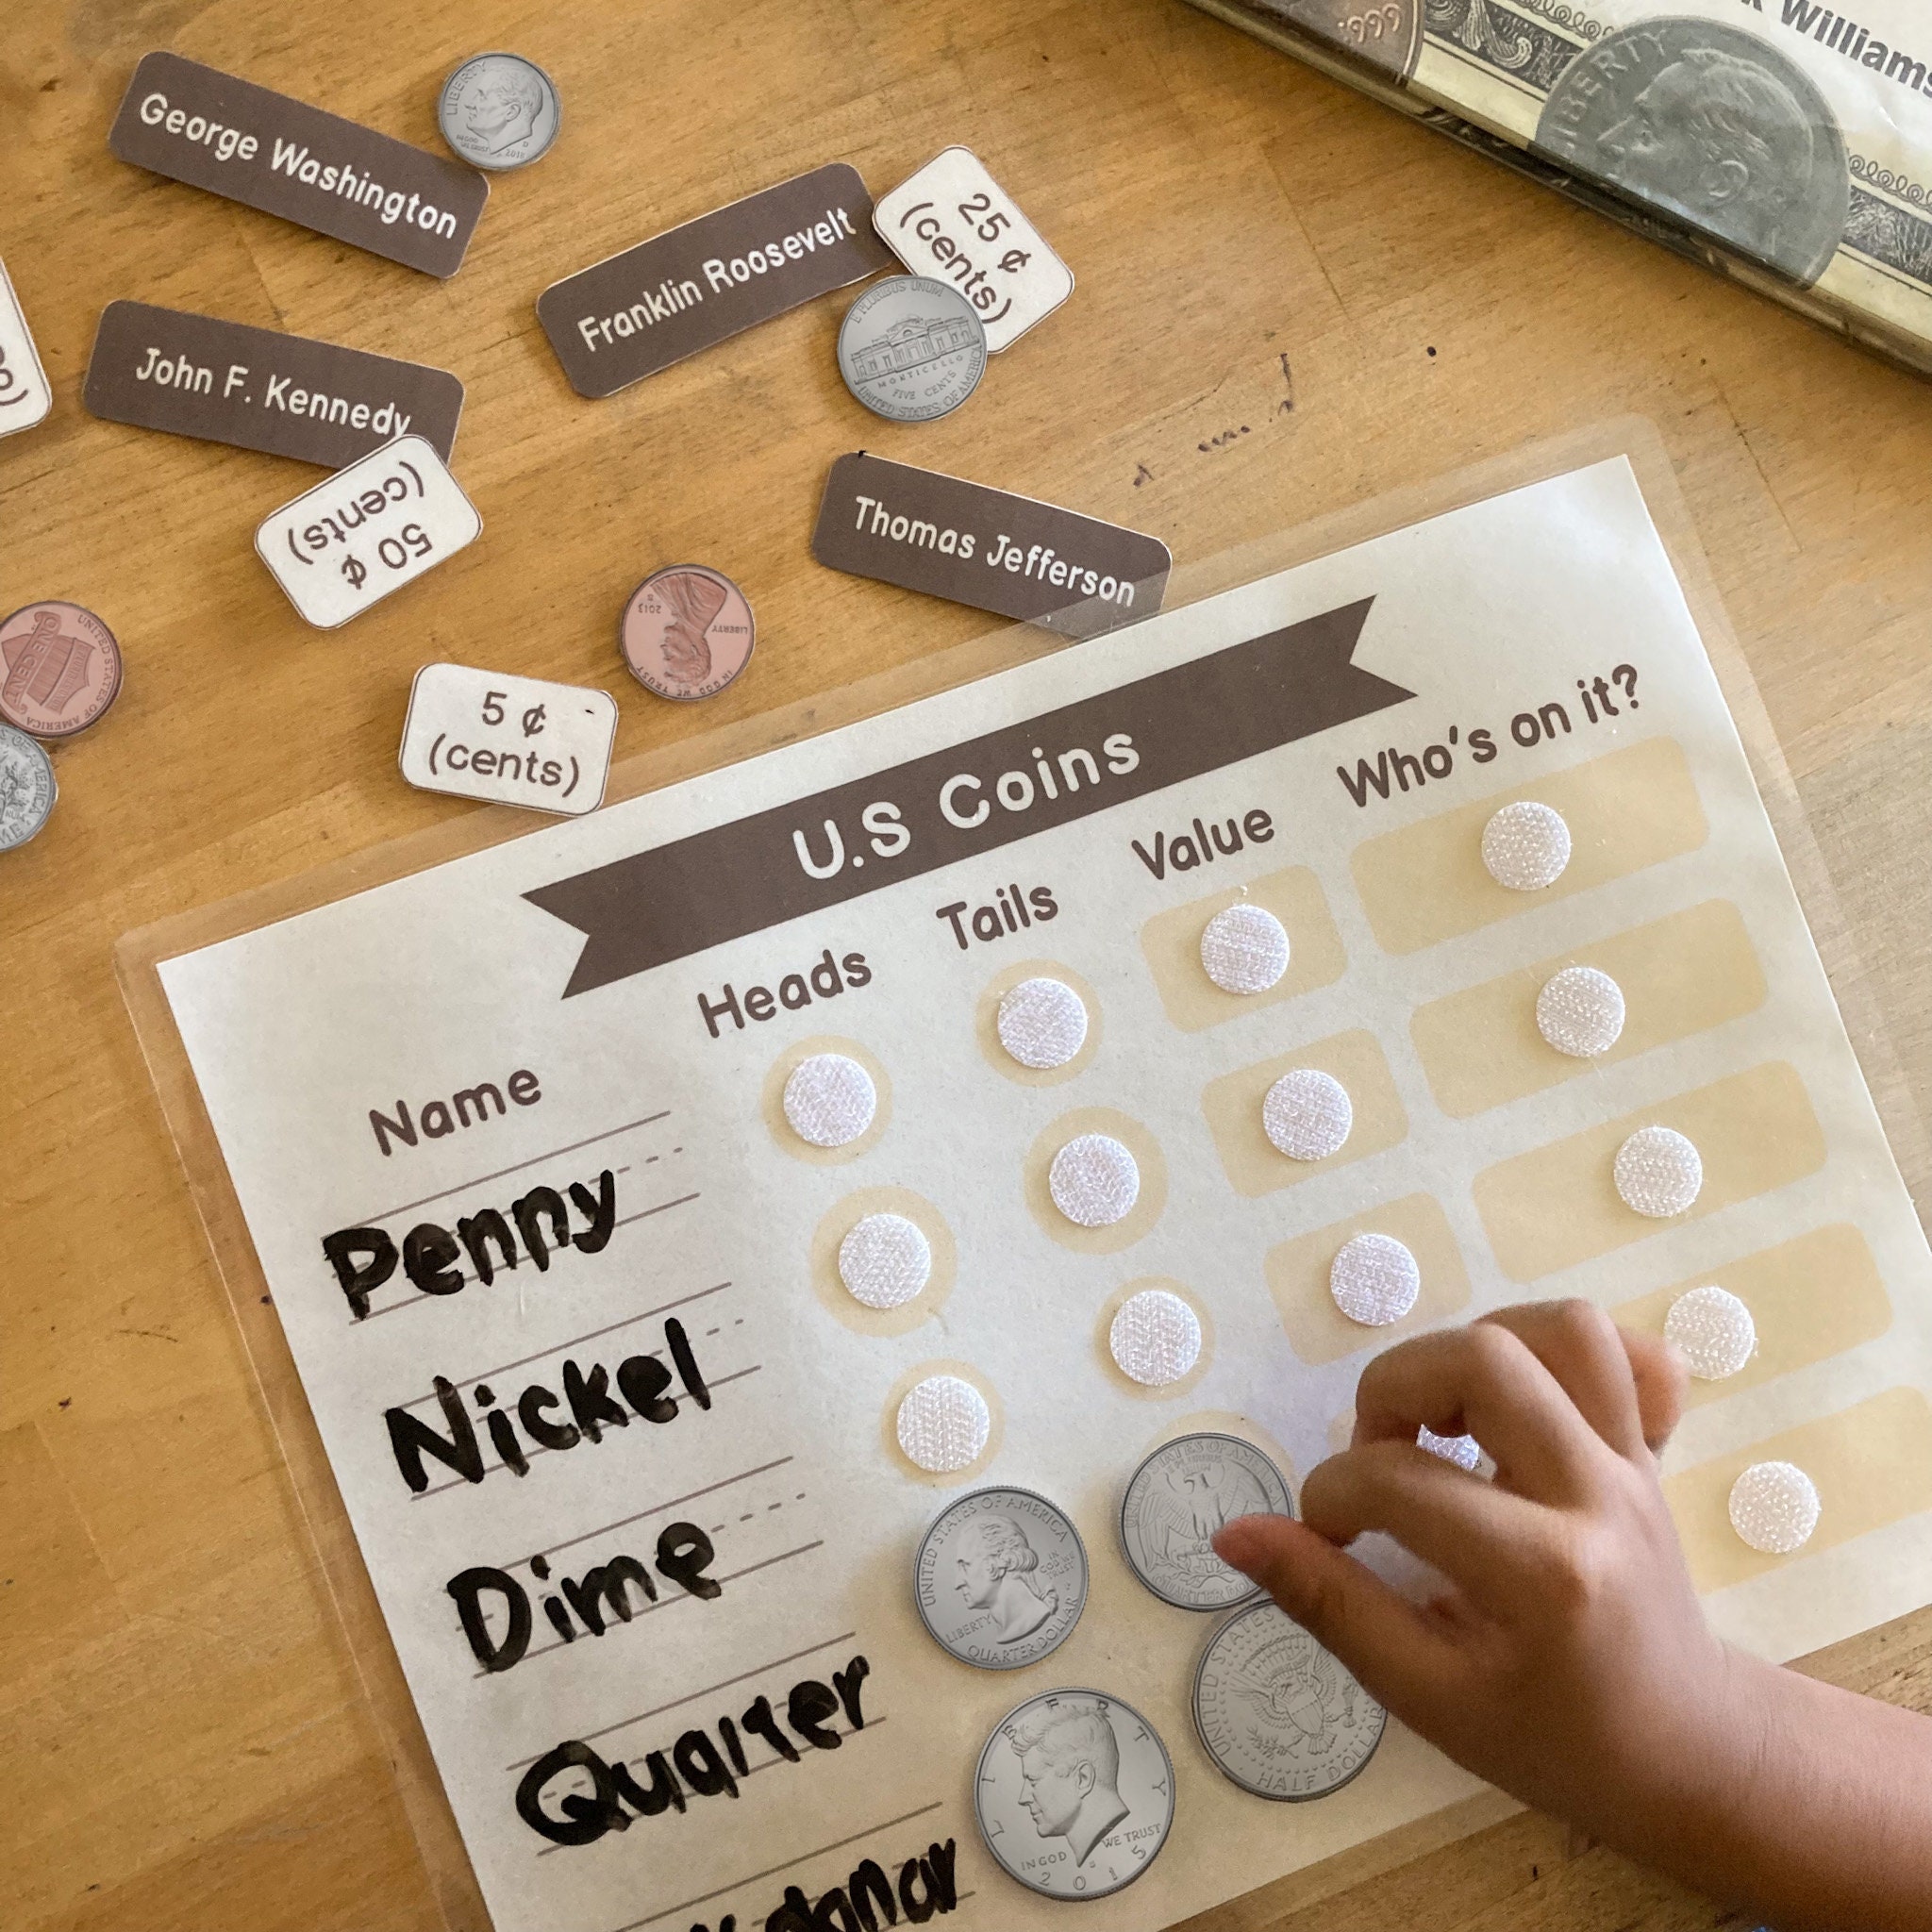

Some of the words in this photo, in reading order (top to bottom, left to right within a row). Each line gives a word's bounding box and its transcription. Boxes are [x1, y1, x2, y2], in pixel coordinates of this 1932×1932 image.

[446, 60, 486, 116] LIBERTY
[141, 93, 258, 161] George
[270, 138, 457, 239] Washington
[900, 202, 1012, 324] (cents)
[958, 193, 1011, 242] 25
[997, 250, 1031, 274] ¢
[577, 279, 703, 352] Franklin
[702, 208, 857, 293] Roosevelt
[861, 281, 907, 314] PLURIBUS
[911, 281, 943, 297] UNUM
[136, 348, 212, 394] John
[224, 365, 251, 403] F.
[264, 374, 410, 436] Kennedy
[858, 385, 894, 415] UNITED
[898, 402, 941, 418] STATES
[945, 393, 958, 408] OF
[959, 345, 982, 396] AMERICA
[877, 354, 963, 389] MONTICELLO
[892, 389, 916, 400] FIVE
[924, 370, 957, 397] CENTS
[288, 460, 425, 565] (cents)
[341, 554, 367, 591] ¢
[378, 524, 433, 569] 50
[856, 495, 976, 559] Thomas
[987, 534, 1135, 607] Jefferson
[32, 616, 58, 653] ONE
[77, 614, 111, 655] UNITED
[638, 603, 661, 614] 2013
[711, 625, 748, 634] LIBERTY
[6, 655, 36, 704] CENT
[96, 658, 113, 704] STATES
[637, 665, 669, 692] TRUST
[699, 681, 721, 695] GOD
[722, 670, 733, 681] IN
[26, 715, 79, 730] AMERICA
[85, 703, 97, 718] OF
[481, 691, 508, 725] 5
[522, 704, 547, 738] ¢
[1337, 724, 1497, 808] Who's
[1510, 703, 1572, 747] on
[1576, 664, 1640, 724] it?
[429, 733, 579, 797] (cents)
[792, 801, 911, 880] U.S
[939, 733, 1141, 829] Coins
[1131, 808, 1274, 880] Value
[936, 883, 1058, 950] Tails
[697, 949, 873, 1038] Heads
[369, 1069, 541, 1157] Name
[323, 1169, 615, 1321] Penny
[384, 1317, 711, 1493] Nickel
[1125, 1474, 1152, 1529] UNITED
[1151, 1441, 1203, 1475] STATES
[921, 1547, 937, 1607] UNITED
[933, 1502, 976, 1544] STATES
[981, 1494, 1002, 1508] OF
[1007, 1497, 1068, 1543] AMERICA
[447, 1522, 722, 1672] Dime
[1152, 1574, 1224, 1603] QUARTER
[944, 1614, 991, 1643] LIBERTY
[967, 1642, 1039, 1663] QUARTER
[1038, 1597, 1079, 1649] DOLLAR
[1210, 1607, 1274, 1665] STATES
[1200, 1674, 1232, 1757] UNITED
[515, 1656, 870, 1845] Quarter
[1257, 1771, 1316, 1791] HALF
[1326, 1706, 1385, 1781] DOLLAR
[1021, 1858, 1036, 1871] IN
[1039, 1851, 1067, 1867] GOD
[1101, 1833, 1121, 1849] WE
[1124, 1823, 1161, 1842] TRUST
[1040, 1845, 1146, 1891] 2015
